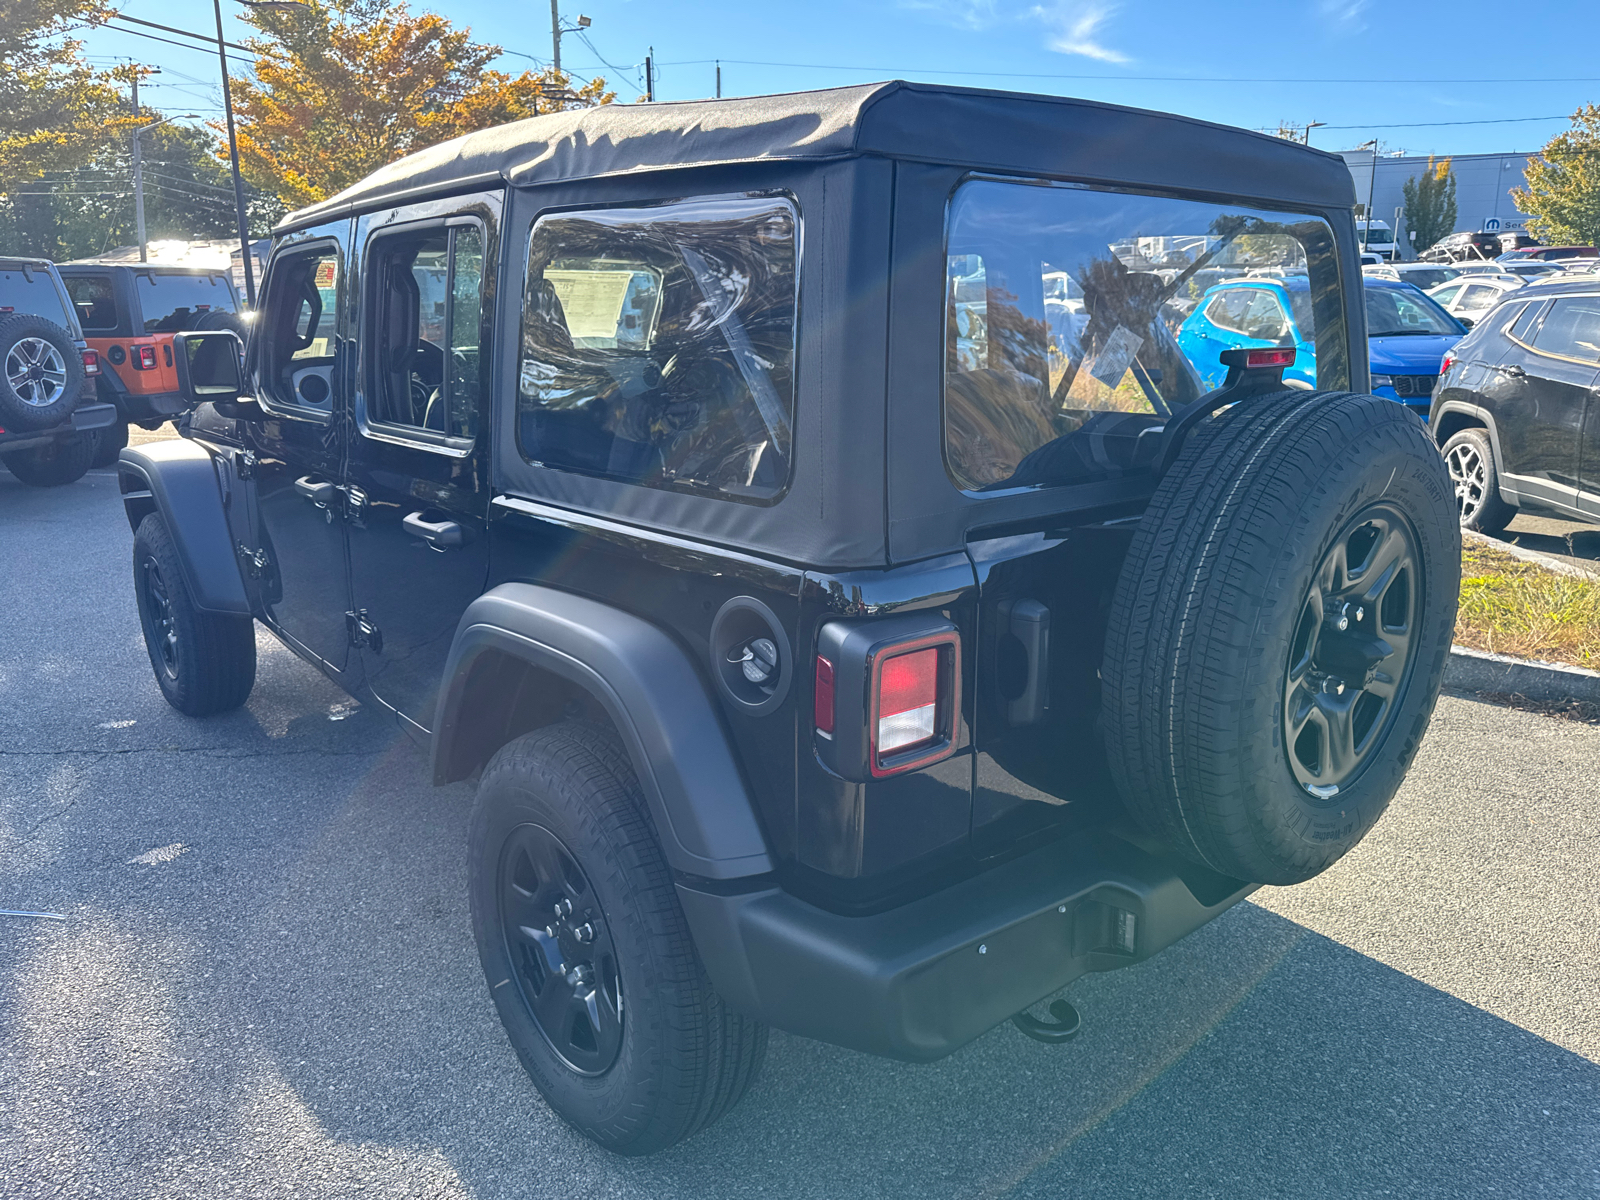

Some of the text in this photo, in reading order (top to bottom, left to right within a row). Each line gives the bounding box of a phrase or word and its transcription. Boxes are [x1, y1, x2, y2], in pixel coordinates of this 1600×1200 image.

[1411, 468, 1442, 503] 245/75R17
[1397, 618, 1450, 768] NEXEN
[1311, 821, 1354, 843] All-Weather
